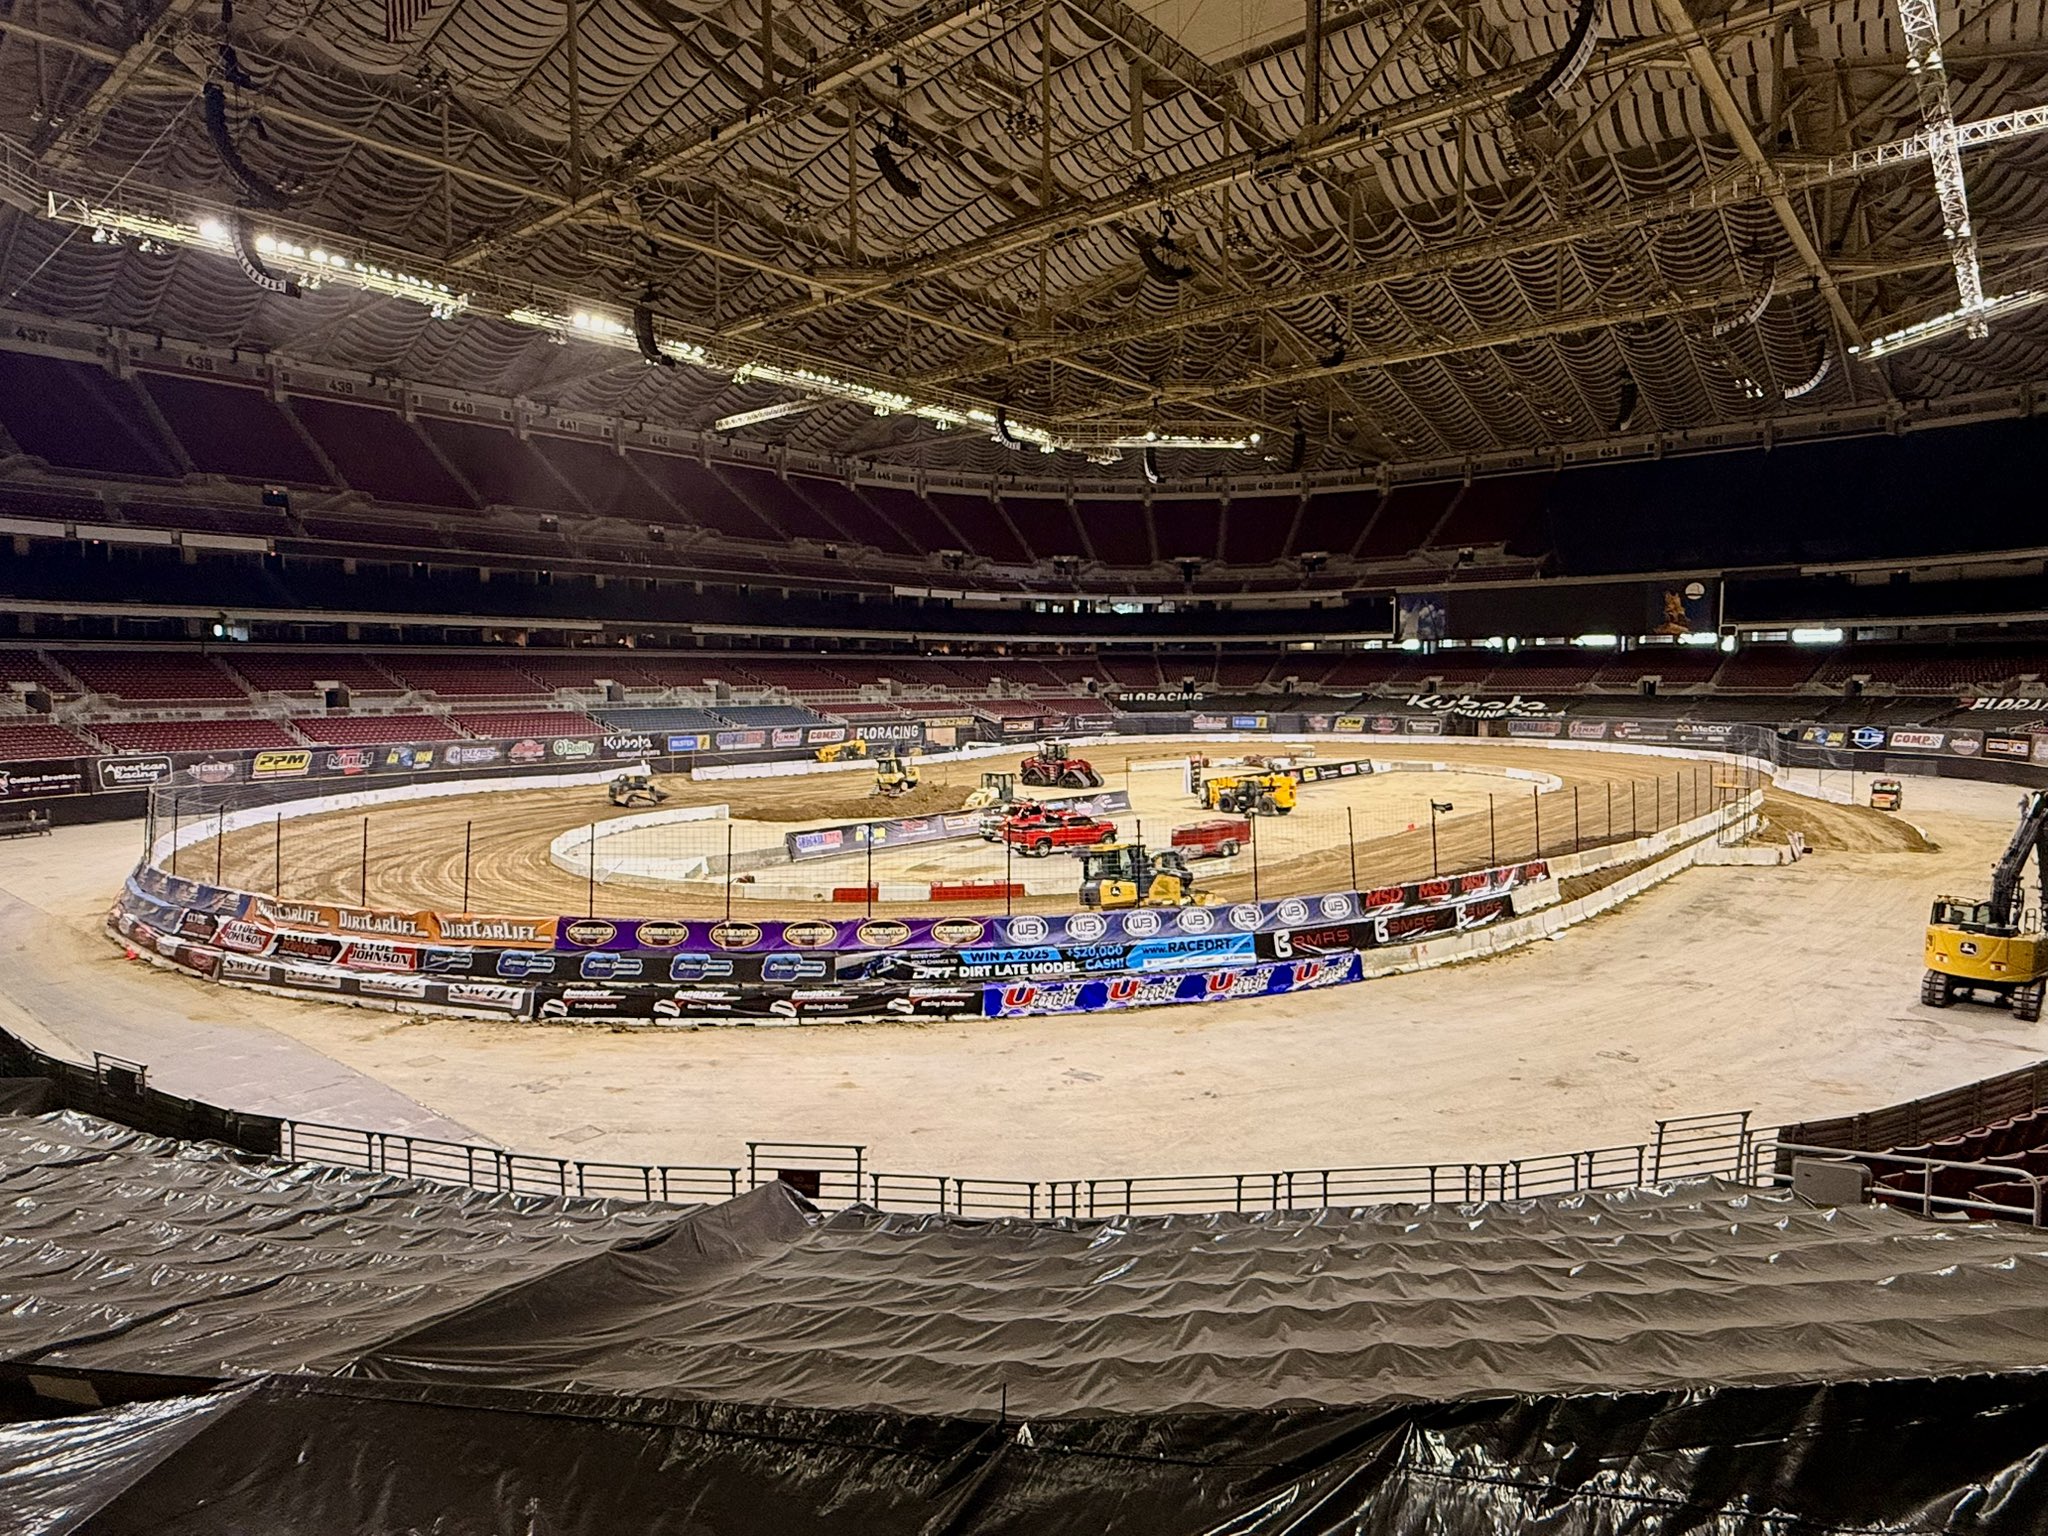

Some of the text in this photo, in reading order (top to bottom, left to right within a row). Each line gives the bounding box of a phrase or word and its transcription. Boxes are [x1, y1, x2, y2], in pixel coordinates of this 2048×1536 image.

[329, 380, 353, 394] 439
[452, 401, 473, 414] 440
[559, 420, 577, 432] 441
[652, 436, 668, 447] 442
[1406, 695, 1546, 709] Kubota
[810, 731, 836, 740] COMP
[857, 725, 919, 740] FLORACING
[1692, 725, 1733, 734] McCOY
[604, 736, 652, 749] Kubota
[1893, 734, 1931, 745] COMP
[259, 754, 305, 765] PPM
[105, 763, 167, 773] American
[42, 774, 81, 782] Brothers
[114, 770, 159, 781] Racing
[1462, 872, 1488, 891] MSD
[1419, 881, 1450, 898] MSD
[1366, 887, 1403, 907] MSD
[279, 939, 333, 956] JOHNSON
[1066, 944, 1123, 958] +$20,000
[350, 950, 409, 965] JOHNSON
[970, 949, 1049, 962] WIN A 2025
[912, 961, 1080, 979] DRT DIRT LATE MODEL
[1085, 958, 1124, 970] CASH!
[687, 1003, 706, 1011] Racing
[804, 1003, 823, 1011] Racing
